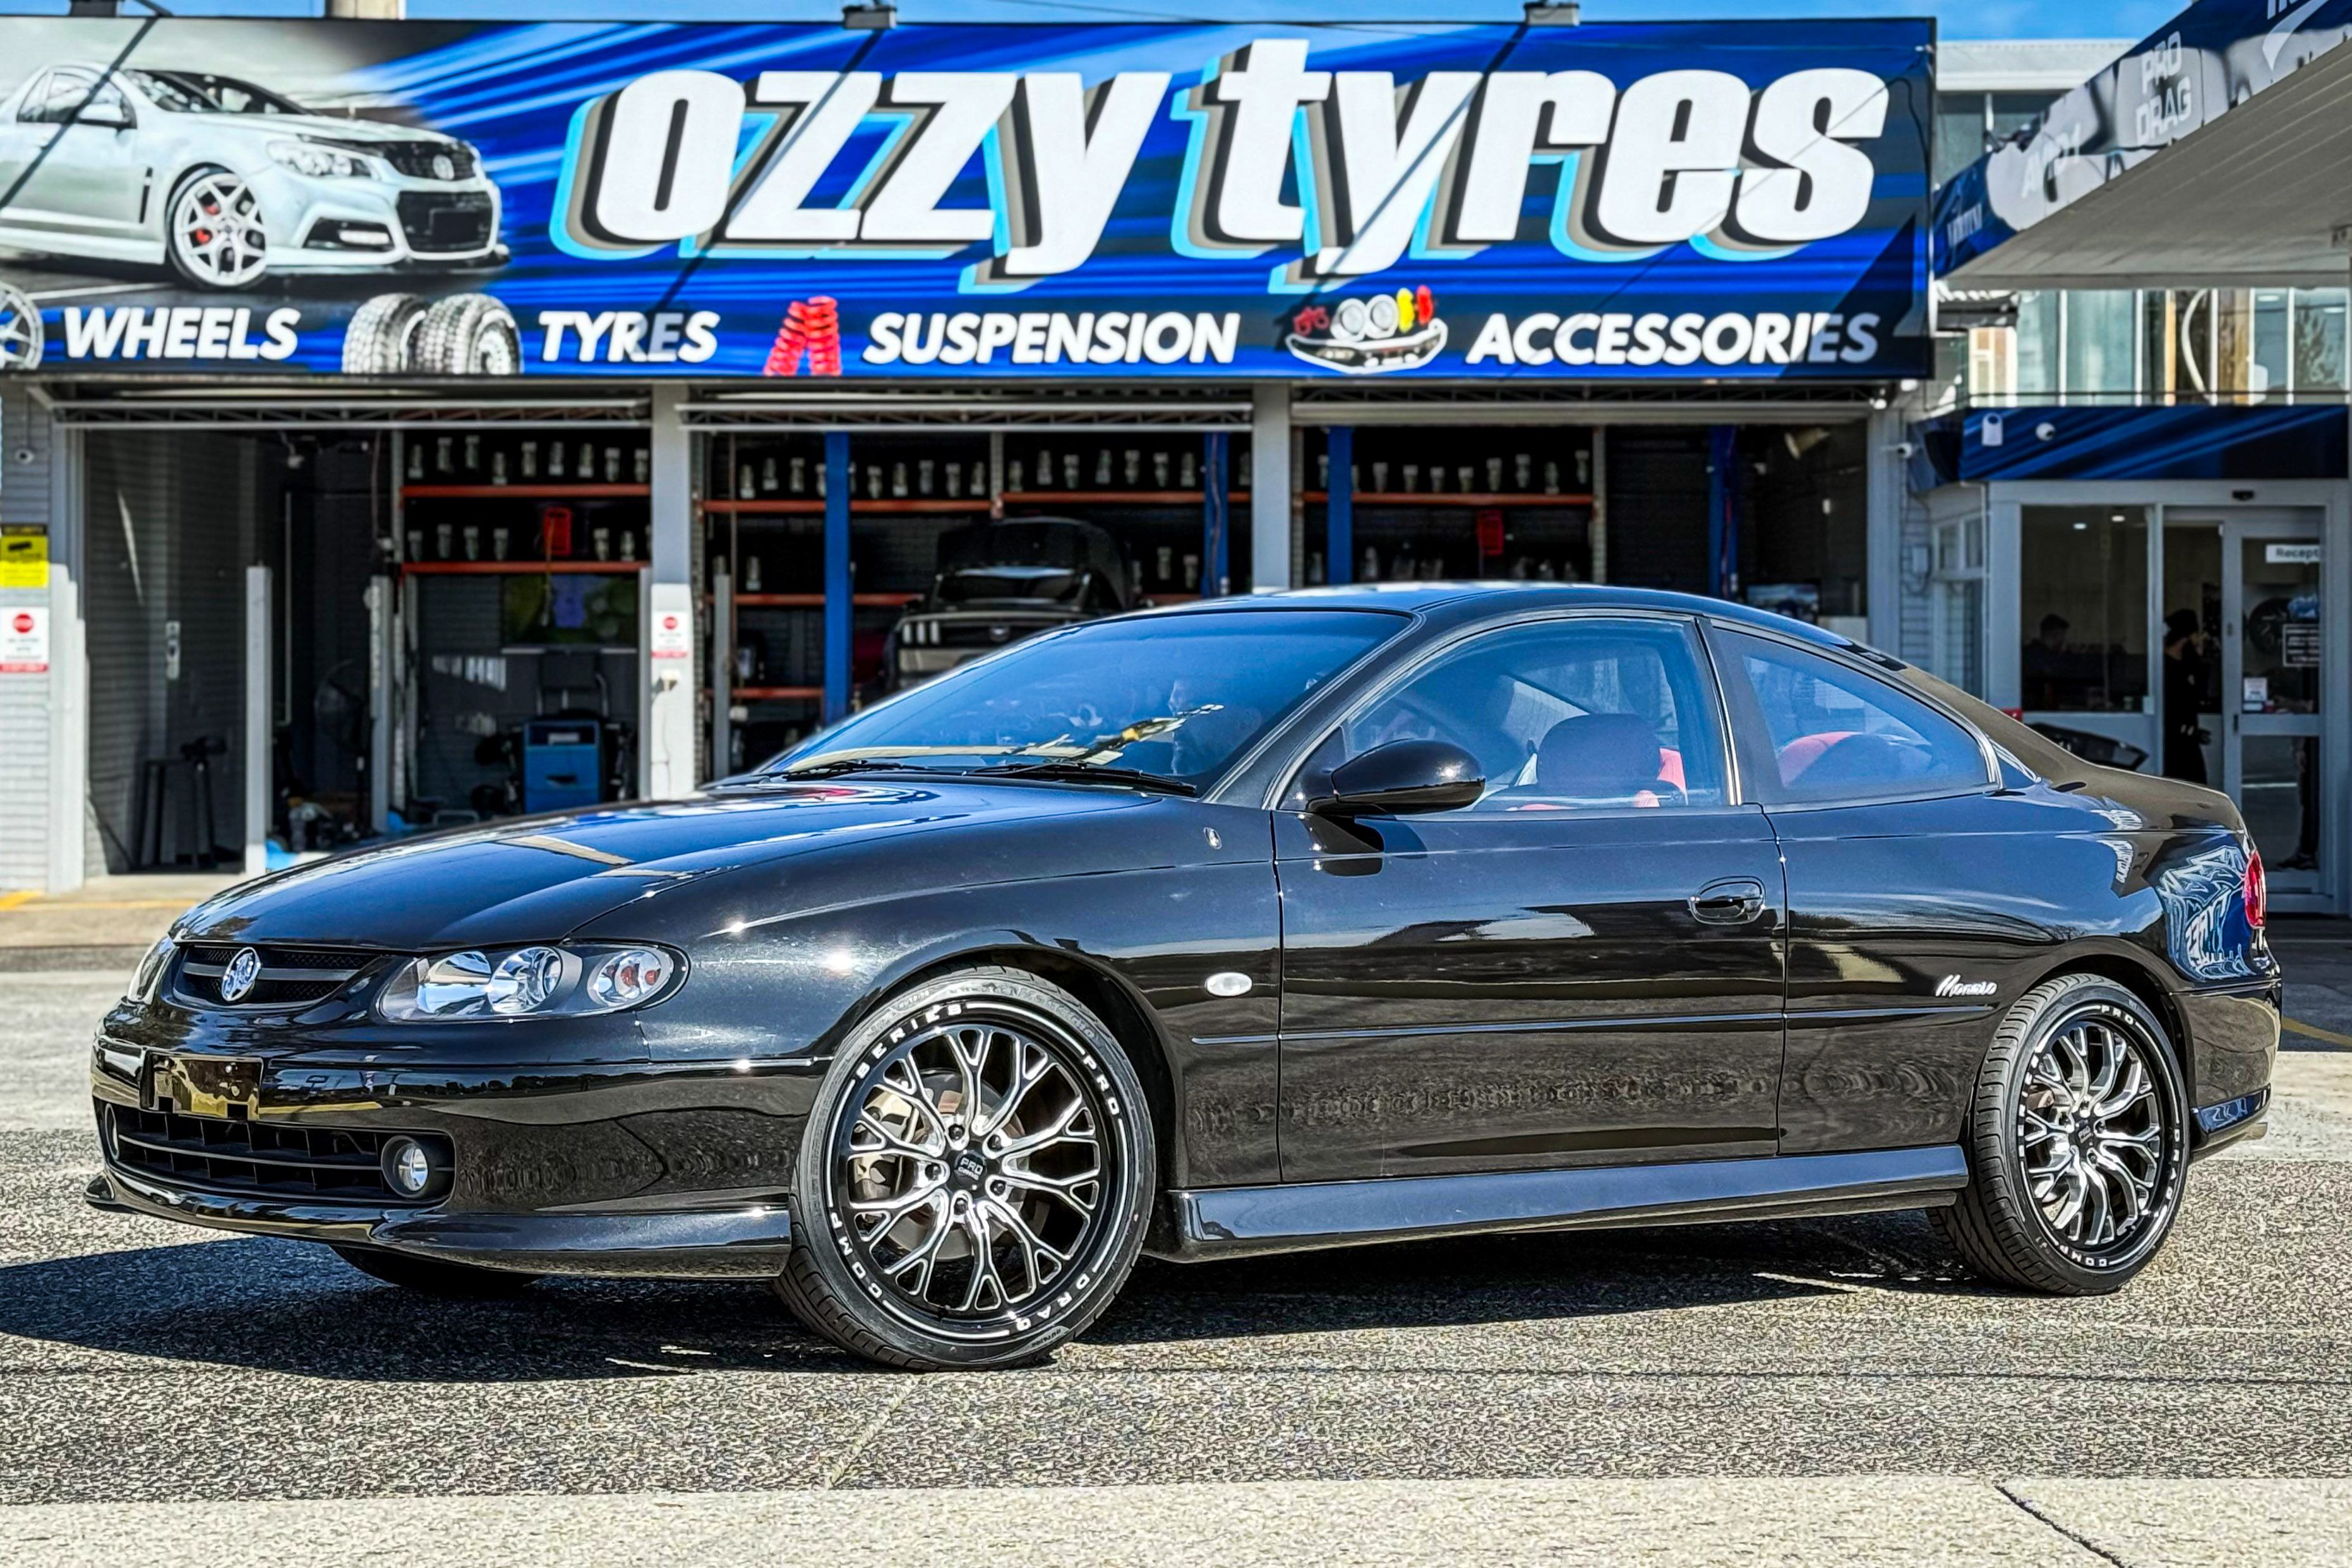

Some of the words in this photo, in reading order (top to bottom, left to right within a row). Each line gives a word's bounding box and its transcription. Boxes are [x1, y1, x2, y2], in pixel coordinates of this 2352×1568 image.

[2141, 30, 2182, 95] PRO
[2135, 76, 2192, 145] DRAG
[596, 69, 1172, 274] ozzy
[1217, 39, 1890, 275] tyres
[64, 307, 301, 359] WHEELS
[538, 311, 720, 362] TYRES
[863, 312, 1240, 364] SUSPENSION
[1465, 313, 1878, 365] ACCESSORIES
[856, 1003, 962, 1079] SERIES
[2101, 1005, 2134, 1026] PRO
[1083, 1055, 1120, 1115] PRO
[960, 1157, 983, 1175] PRO
[831, 1212, 883, 1299] COMP
[1016, 1273, 1090, 1331] DRAG
